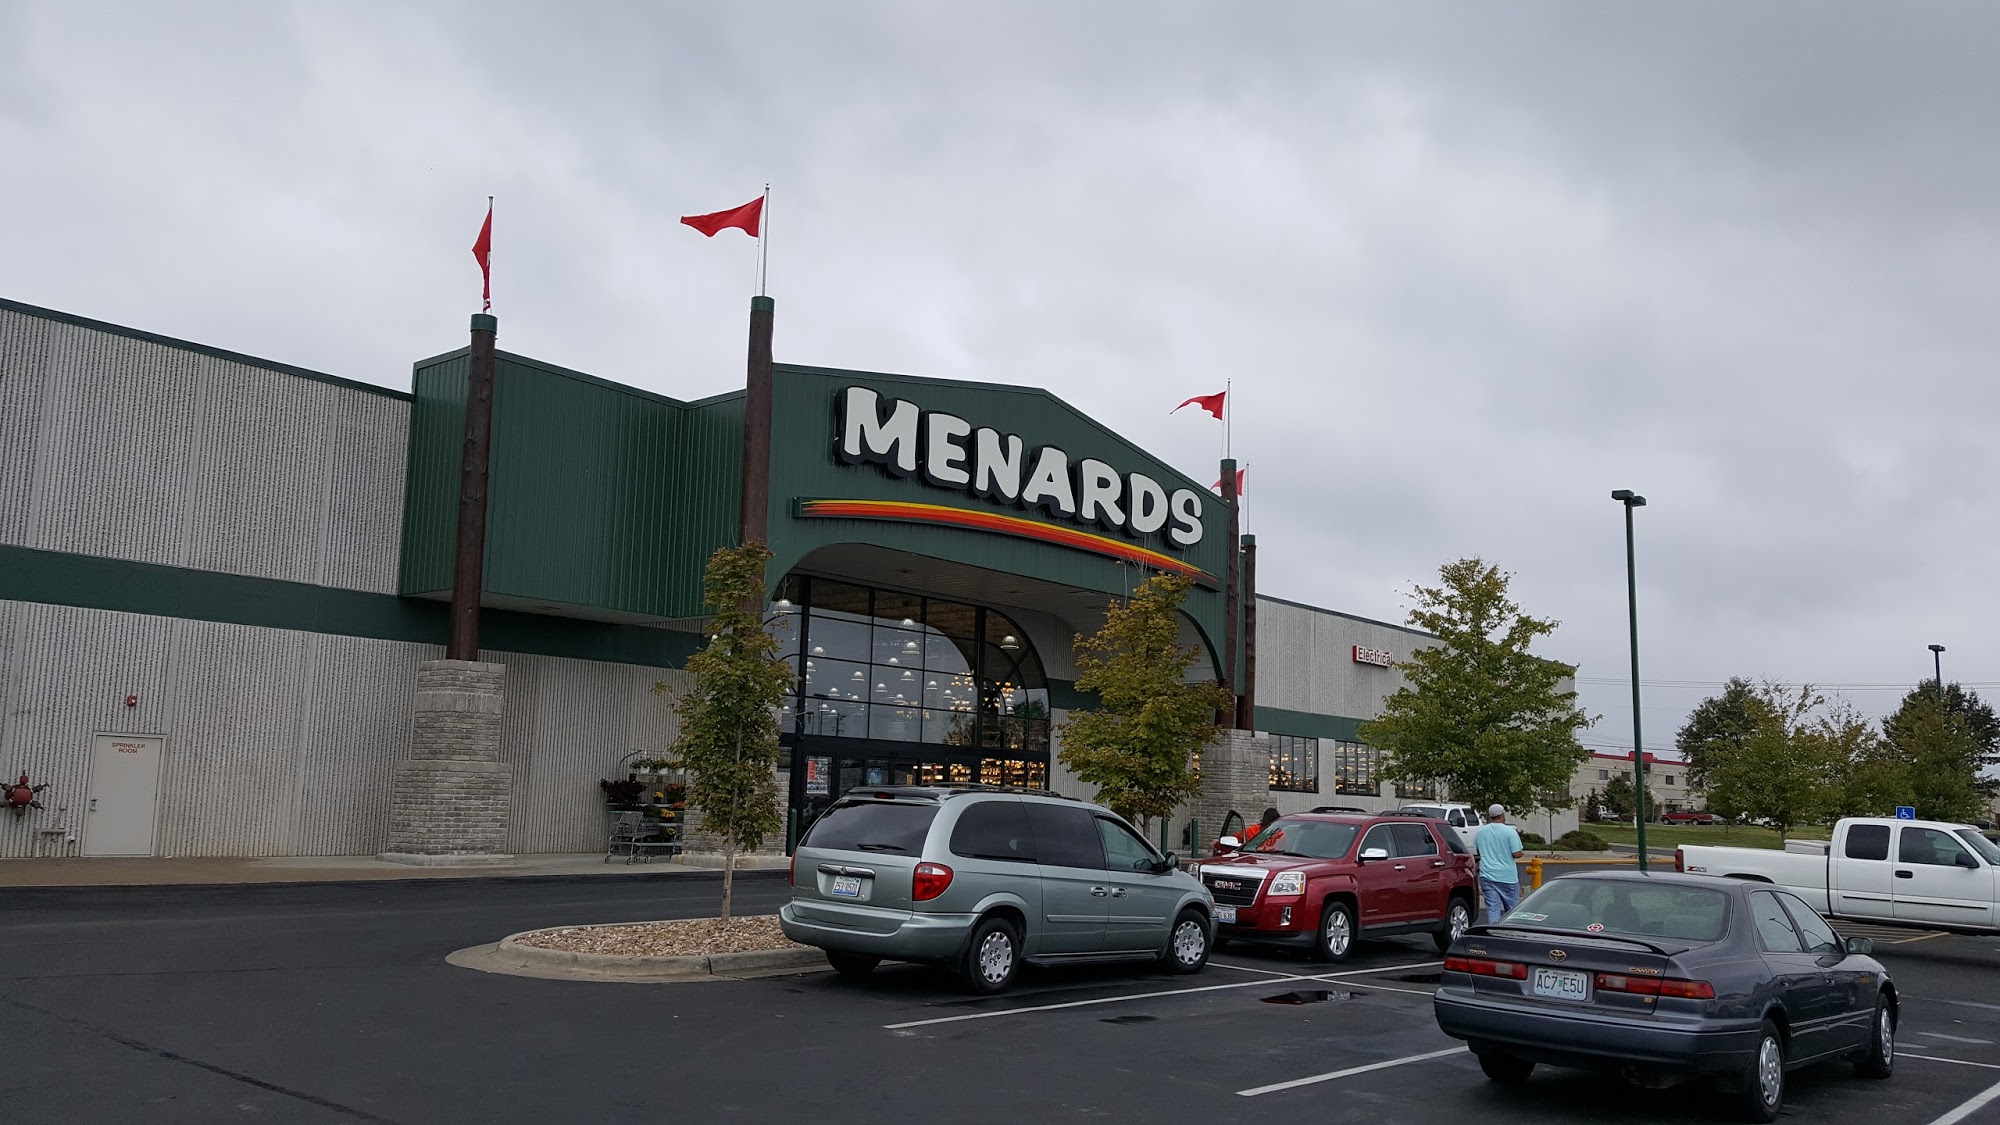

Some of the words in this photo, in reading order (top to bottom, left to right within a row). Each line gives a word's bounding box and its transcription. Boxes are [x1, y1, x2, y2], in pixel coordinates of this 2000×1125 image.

[842, 385, 1204, 546] MENARDS
[1358, 647, 1393, 666] Electrical
[1214, 880, 1242, 891] GMC
[1629, 966, 1660, 975] CAMRY
[1536, 974, 1558, 990] AC7
[1562, 978, 1585, 994] E5U
